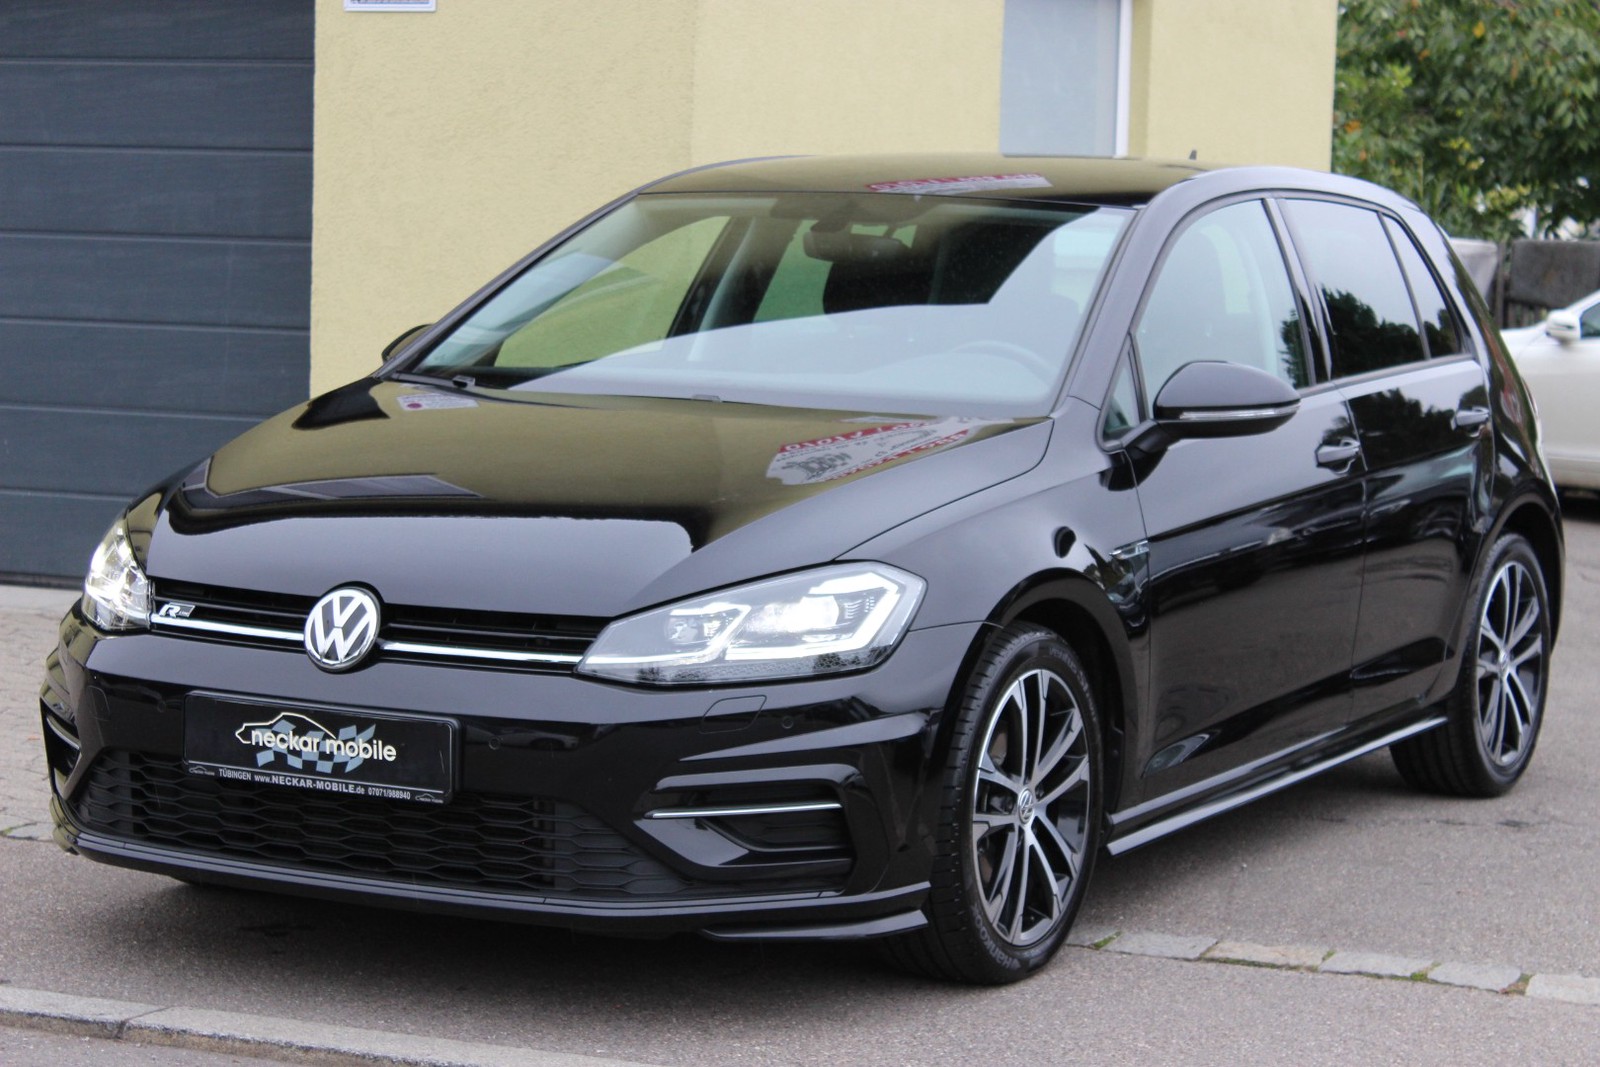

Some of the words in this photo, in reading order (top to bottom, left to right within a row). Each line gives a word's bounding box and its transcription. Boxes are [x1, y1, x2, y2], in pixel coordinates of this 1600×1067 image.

[251, 730, 320, 752] neckar
[325, 738, 397, 762] mobile
[218, 768, 252, 781] TÜBINGEN
[254, 775, 366, 795] www.NECKAR-MOBILE.de
